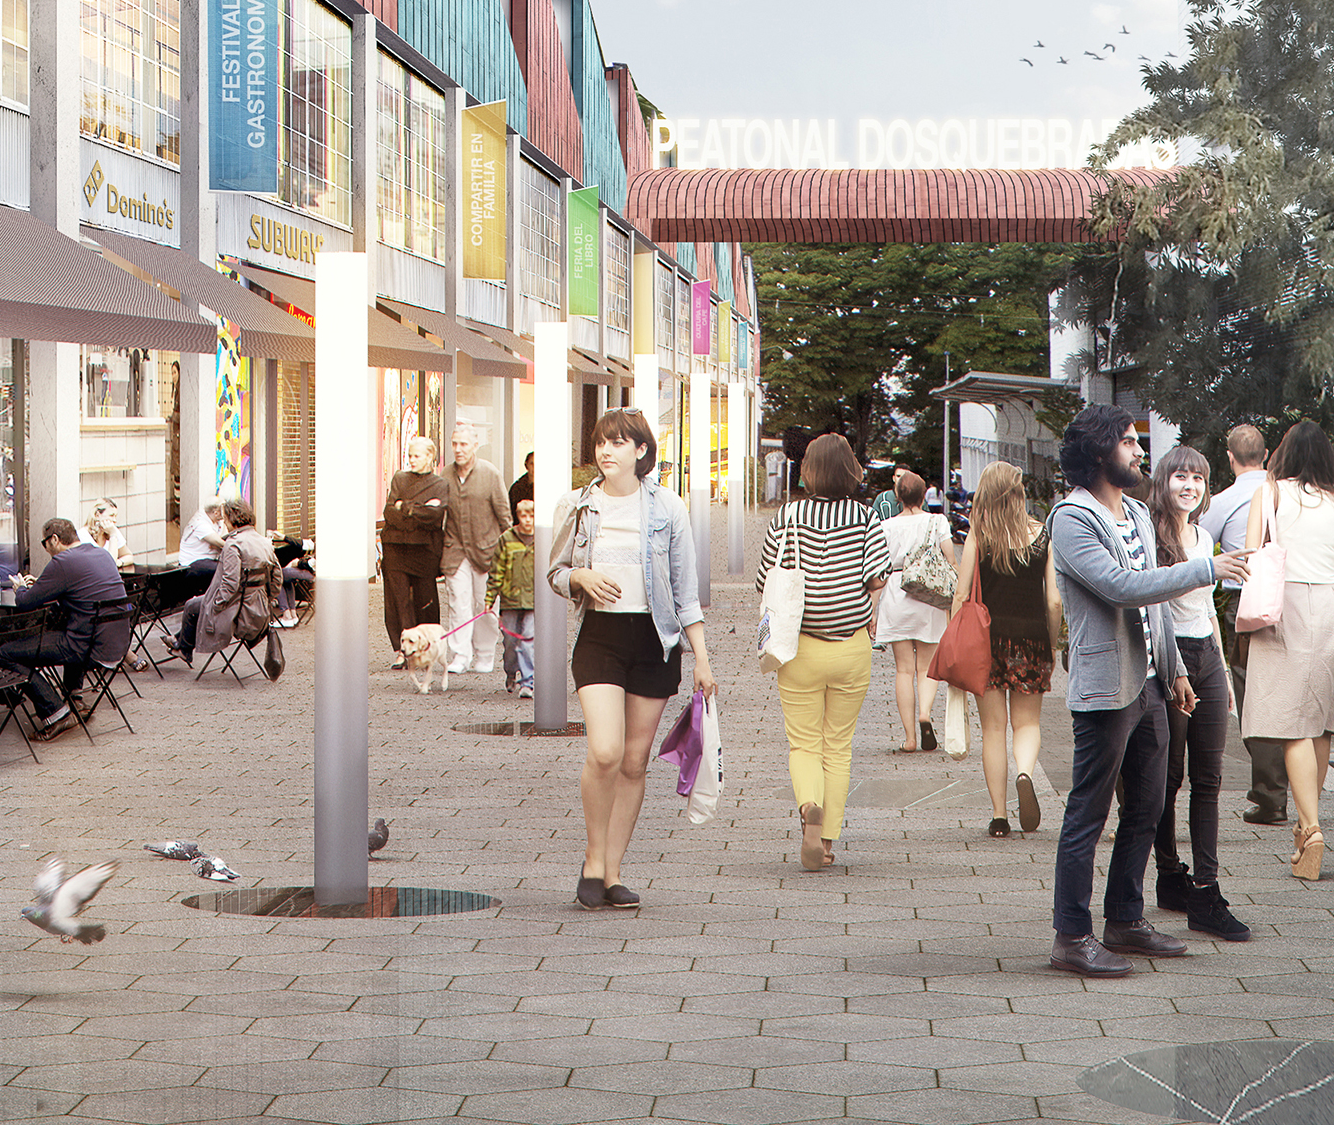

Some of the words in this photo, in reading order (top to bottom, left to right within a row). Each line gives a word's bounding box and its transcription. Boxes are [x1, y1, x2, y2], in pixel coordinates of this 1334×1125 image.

[470, 133, 483, 154] EN
[652, 118, 849, 170] PEATONAL
[106, 182, 174, 230] Domino's
[470, 158, 483, 246] COMPARTIR
[483, 160, 495, 219] FAMILIA
[573, 223, 583, 244] DEL
[584, 234, 594, 268] LIBRO
[573, 247, 583, 279] FERIA
